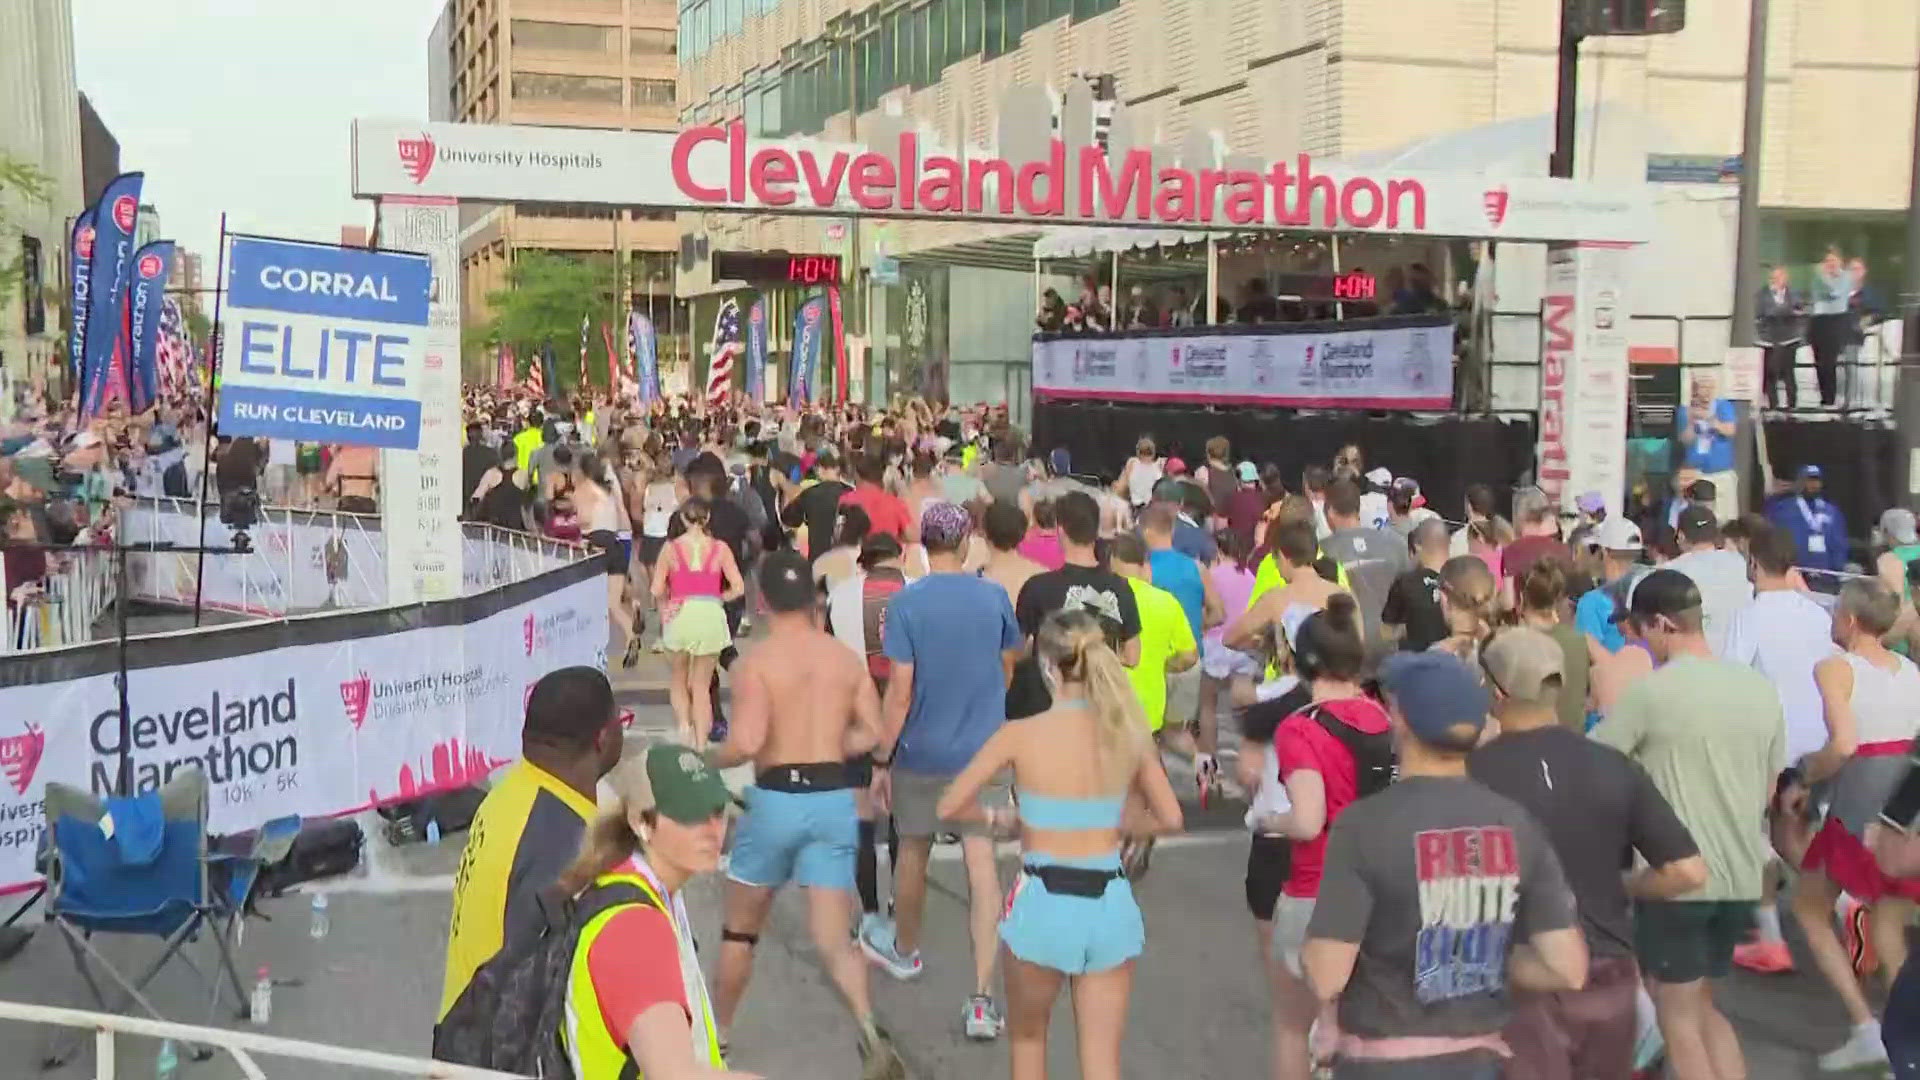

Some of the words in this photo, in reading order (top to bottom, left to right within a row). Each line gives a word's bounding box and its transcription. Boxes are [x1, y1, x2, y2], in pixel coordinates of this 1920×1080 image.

[439, 148, 523, 167] University
[529, 151, 602, 169] Hospitals
[671, 119, 1065, 216] Cleveland
[1078, 145, 1425, 230] Marathon
[260, 265, 398, 302] CORRAL
[789, 256, 837, 283] 1:04
[240, 322, 409, 387] ELITE
[234, 402, 277, 421] RUN
[283, 407, 406, 431] CLEVELAND
[1541, 295, 1576, 507] Marath
[277, 772, 298, 792] 5K
[0, 801, 47, 823] ivers
[1415, 826, 1519, 883] RED
